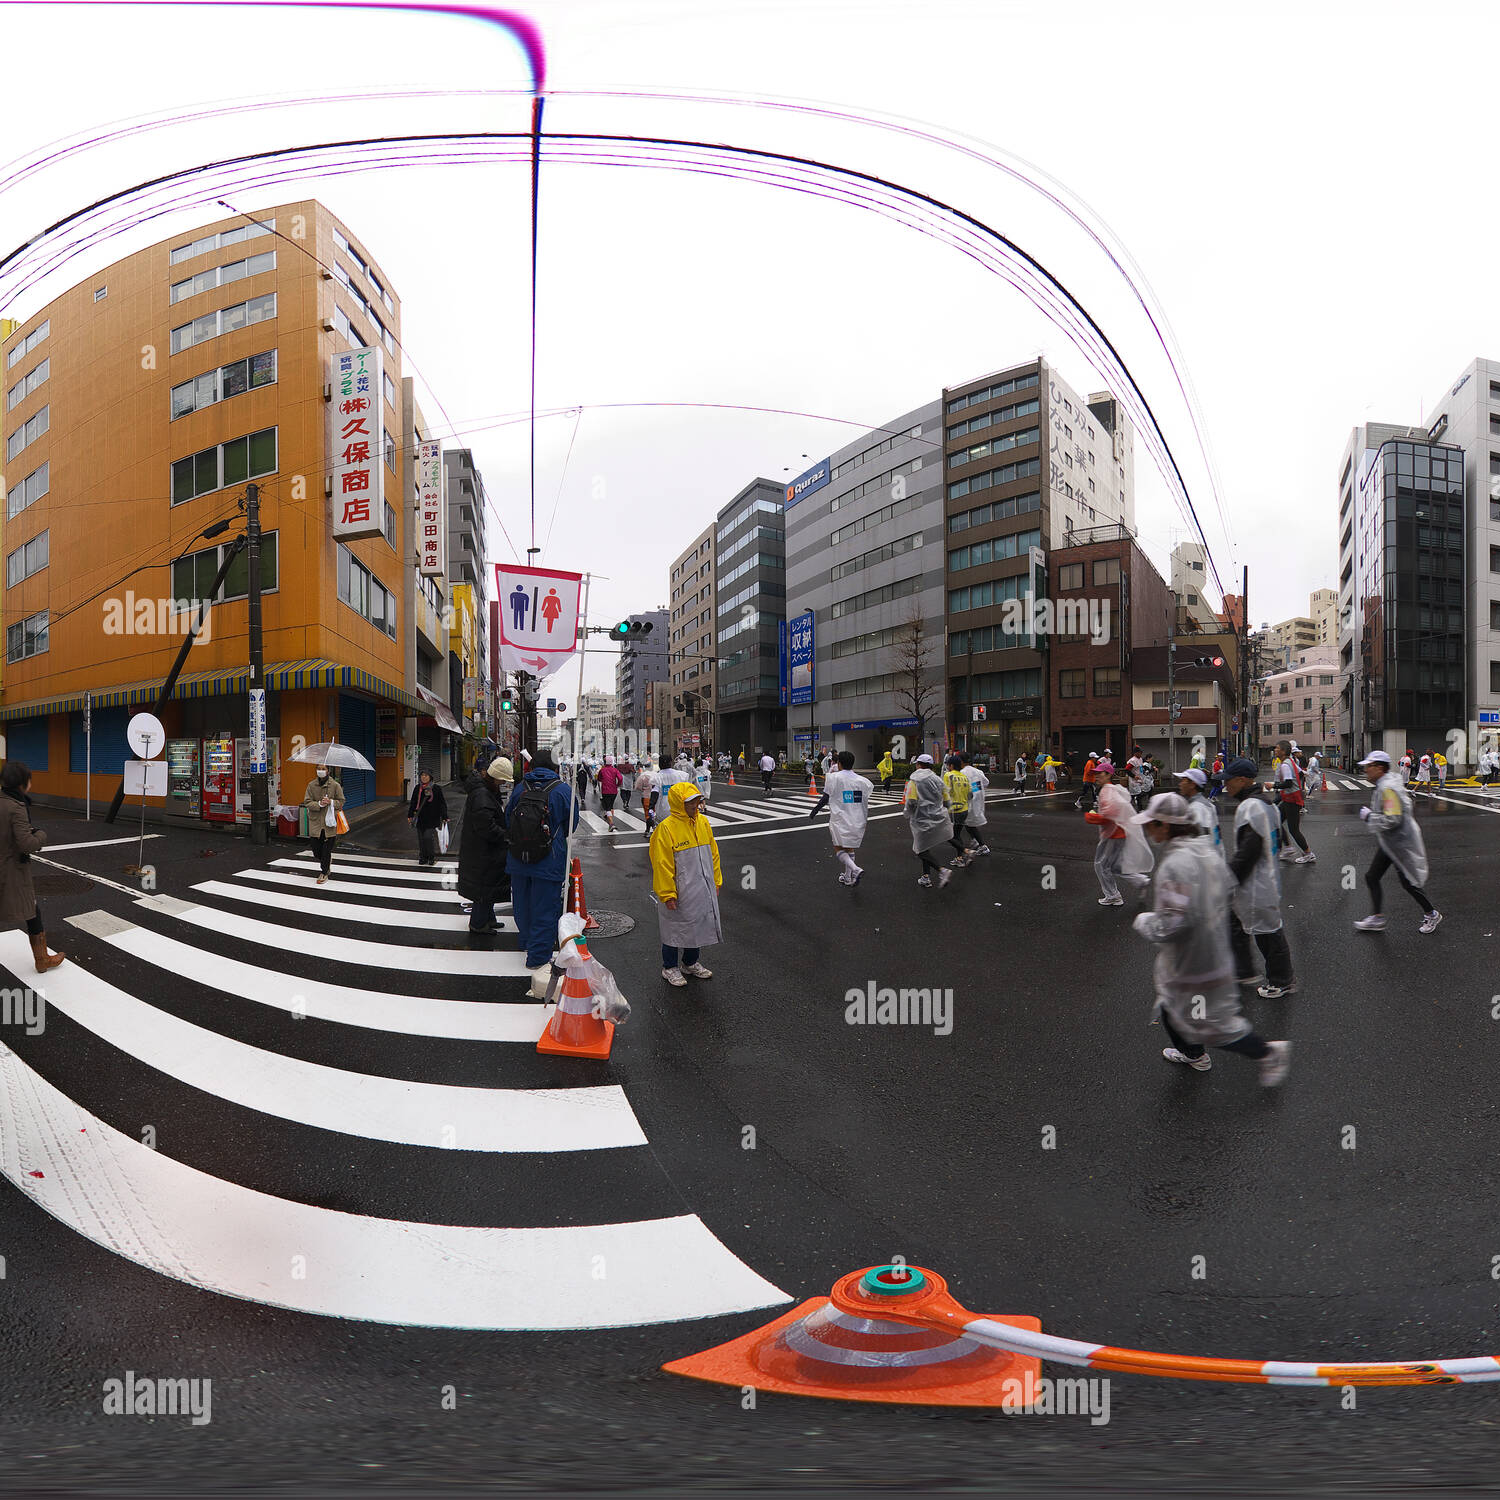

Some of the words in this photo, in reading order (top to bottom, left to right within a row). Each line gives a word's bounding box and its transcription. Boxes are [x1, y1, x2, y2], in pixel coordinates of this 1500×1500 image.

[1050, 380, 1065, 492] ひな人形
[795, 469, 825, 494] Quraz
[424, 511, 438, 567] 町田商店
[792, 617, 812, 632] レンタル
